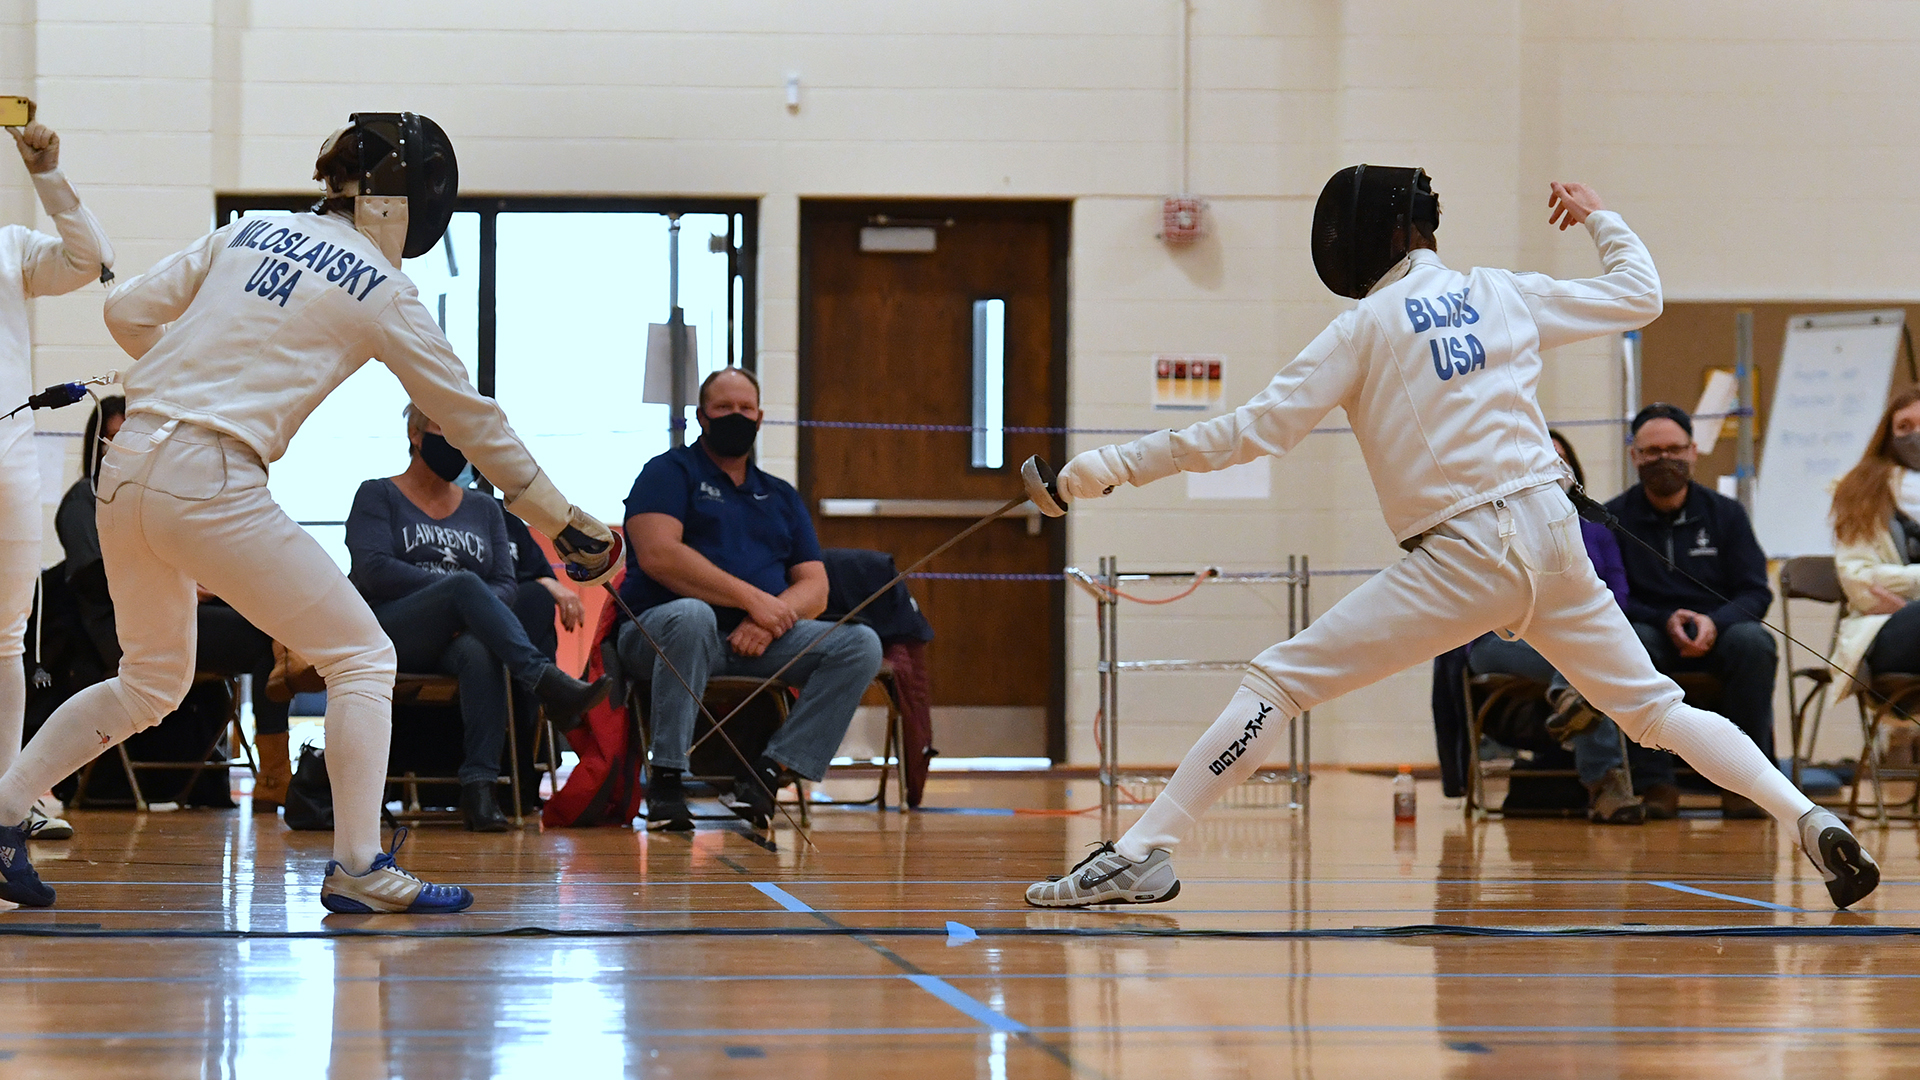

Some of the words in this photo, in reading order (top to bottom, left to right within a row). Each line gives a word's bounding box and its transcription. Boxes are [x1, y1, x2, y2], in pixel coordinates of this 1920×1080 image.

[227, 219, 388, 302] MILOSLAVSKY
[244, 256, 303, 308] USA
[1404, 287, 1480, 334] BLISS
[1429, 333, 1486, 381] USA
[402, 523, 485, 564] LAWRENCE
[1208, 701, 1274, 776] VIKINGS
